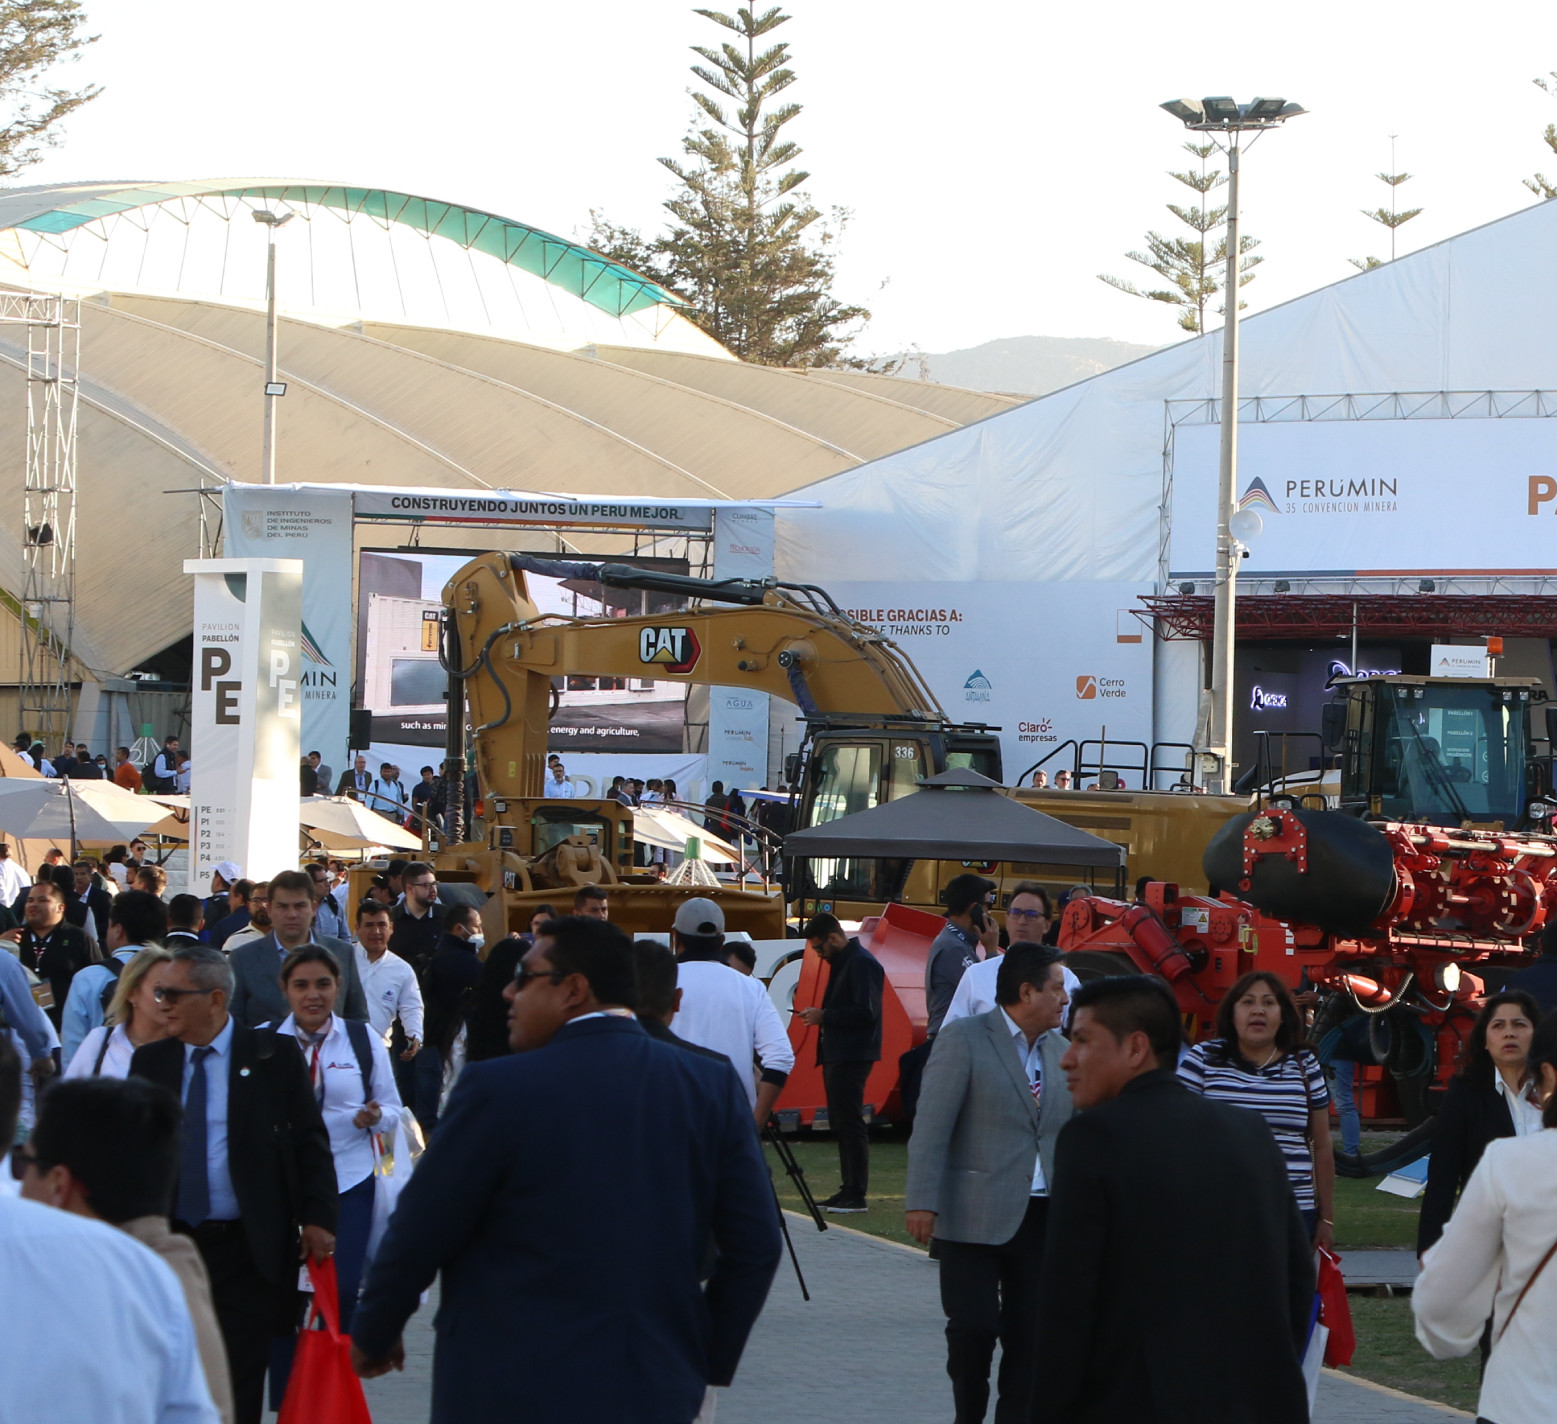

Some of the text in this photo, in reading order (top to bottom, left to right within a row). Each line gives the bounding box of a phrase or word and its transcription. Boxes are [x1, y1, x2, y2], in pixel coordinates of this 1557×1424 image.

[391, 496, 508, 513] CONSTRUYENDO
[510, 502, 566, 515] JUNTOS
[569, 504, 588, 516] UN
[1286, 503, 1296, 513] 35
[1363, 501, 1398, 512] MINERA
[887, 609, 947, 622] GRACIAS
[949, 609, 963, 622] A:
[202, 623, 240, 631] PAVILION
[889, 625, 932, 635] THANKS
[936, 625, 950, 635] TO
[202, 634, 239, 642] PABELLÓN
[640, 627, 687, 663] CAT
[1100, 677, 1125, 687] Cerro
[1100, 688, 1127, 697] Verde
[401, 720, 421, 730] such
[422, 722, 432, 730] as
[1018, 721, 1048, 733] Claro
[550, 725, 640, 737] energy and agriculture,
[1018, 734, 1058, 743] empresas
[894, 746, 914, 759] 336
[201, 806, 212, 814] PE
[200, 830, 211, 838] P2
[200, 871, 210, 879] P5
